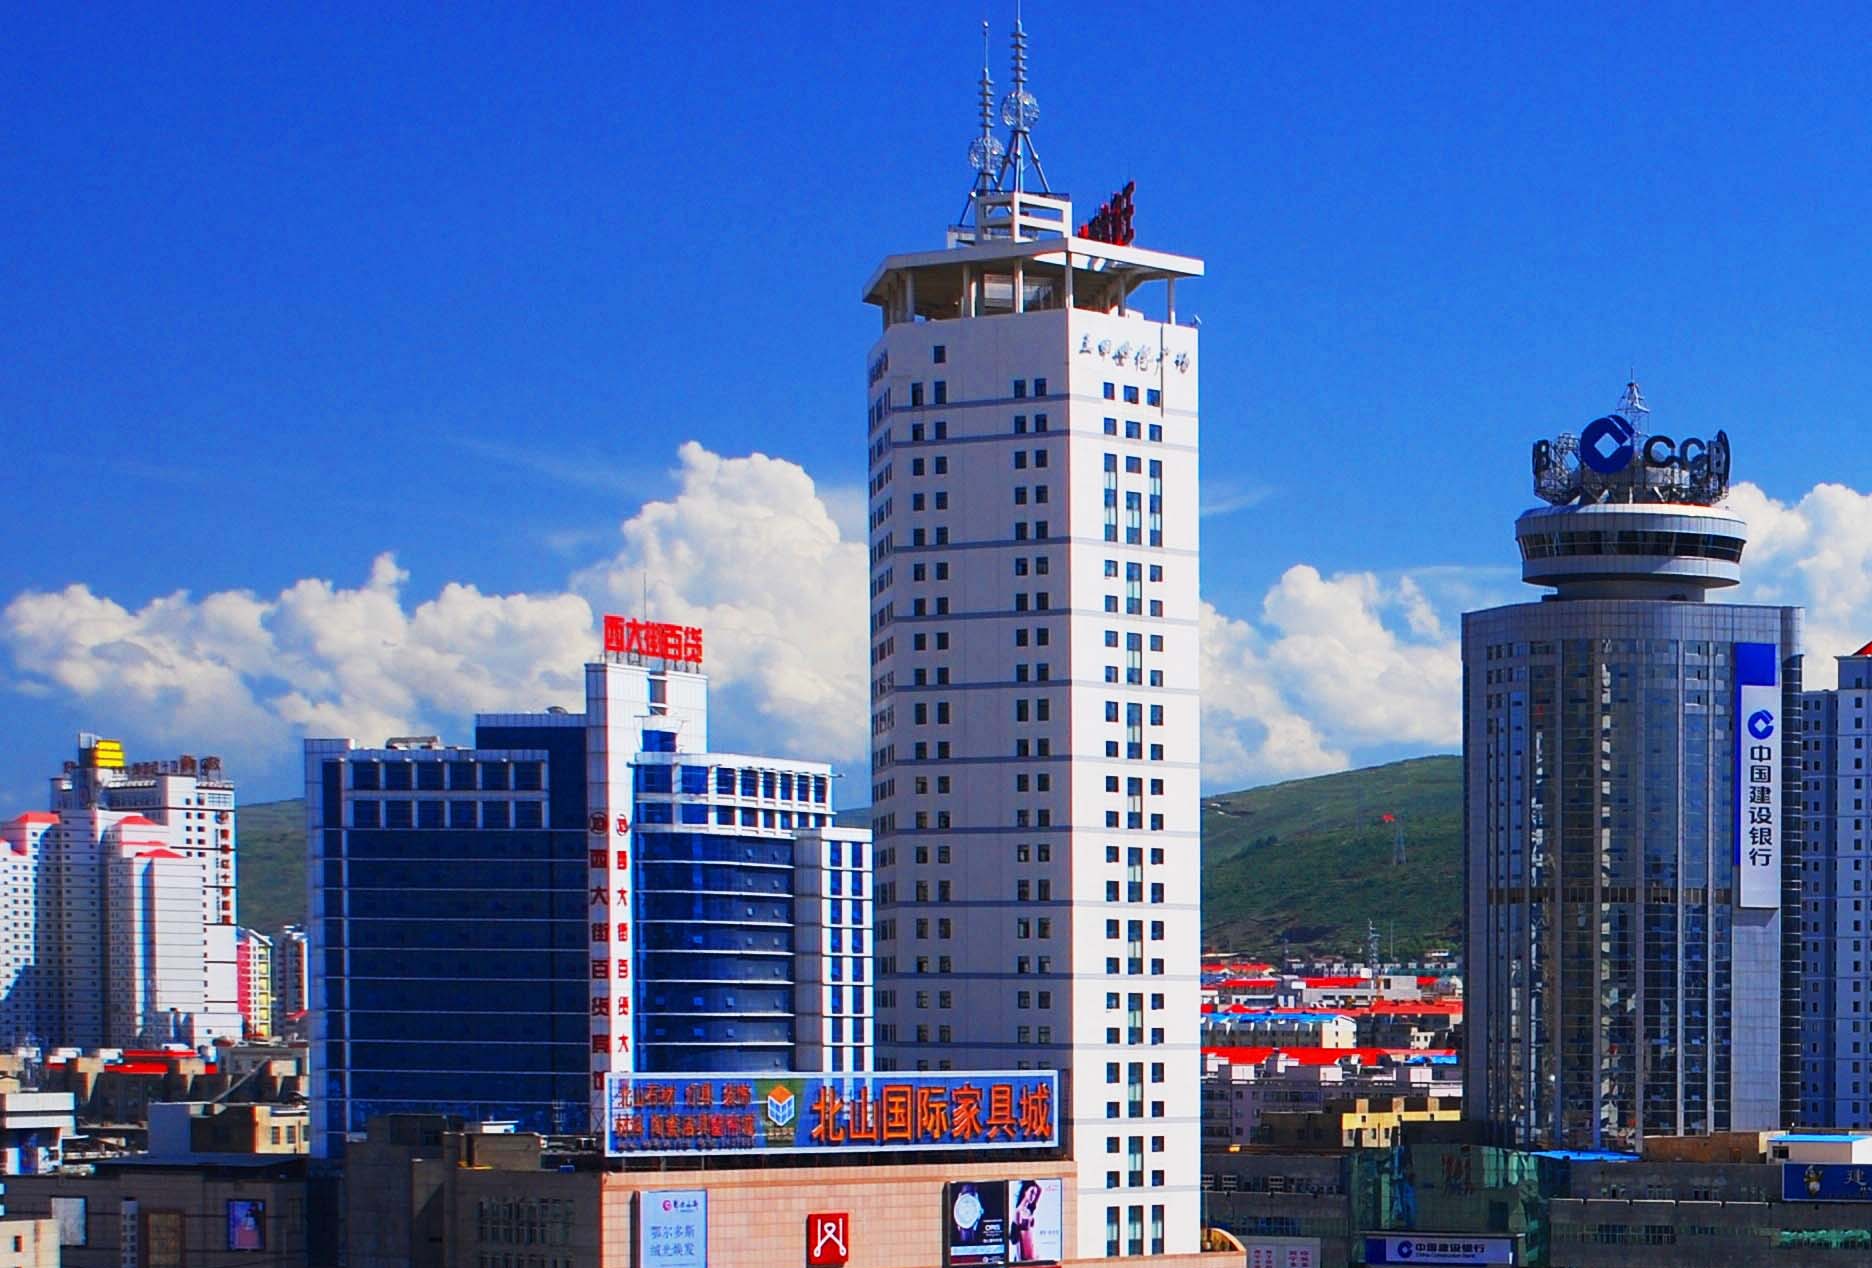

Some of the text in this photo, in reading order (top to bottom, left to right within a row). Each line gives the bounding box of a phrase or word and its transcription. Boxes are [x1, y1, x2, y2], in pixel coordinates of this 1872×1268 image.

[1749, 746, 1773, 867] 中国建设银行
[616, 851, 629, 1073] 西大街百货大
[811, 1082, 1051, 1142] 北山国际家具城
[1416, 1243, 1485, 1253] 中国建设银行
